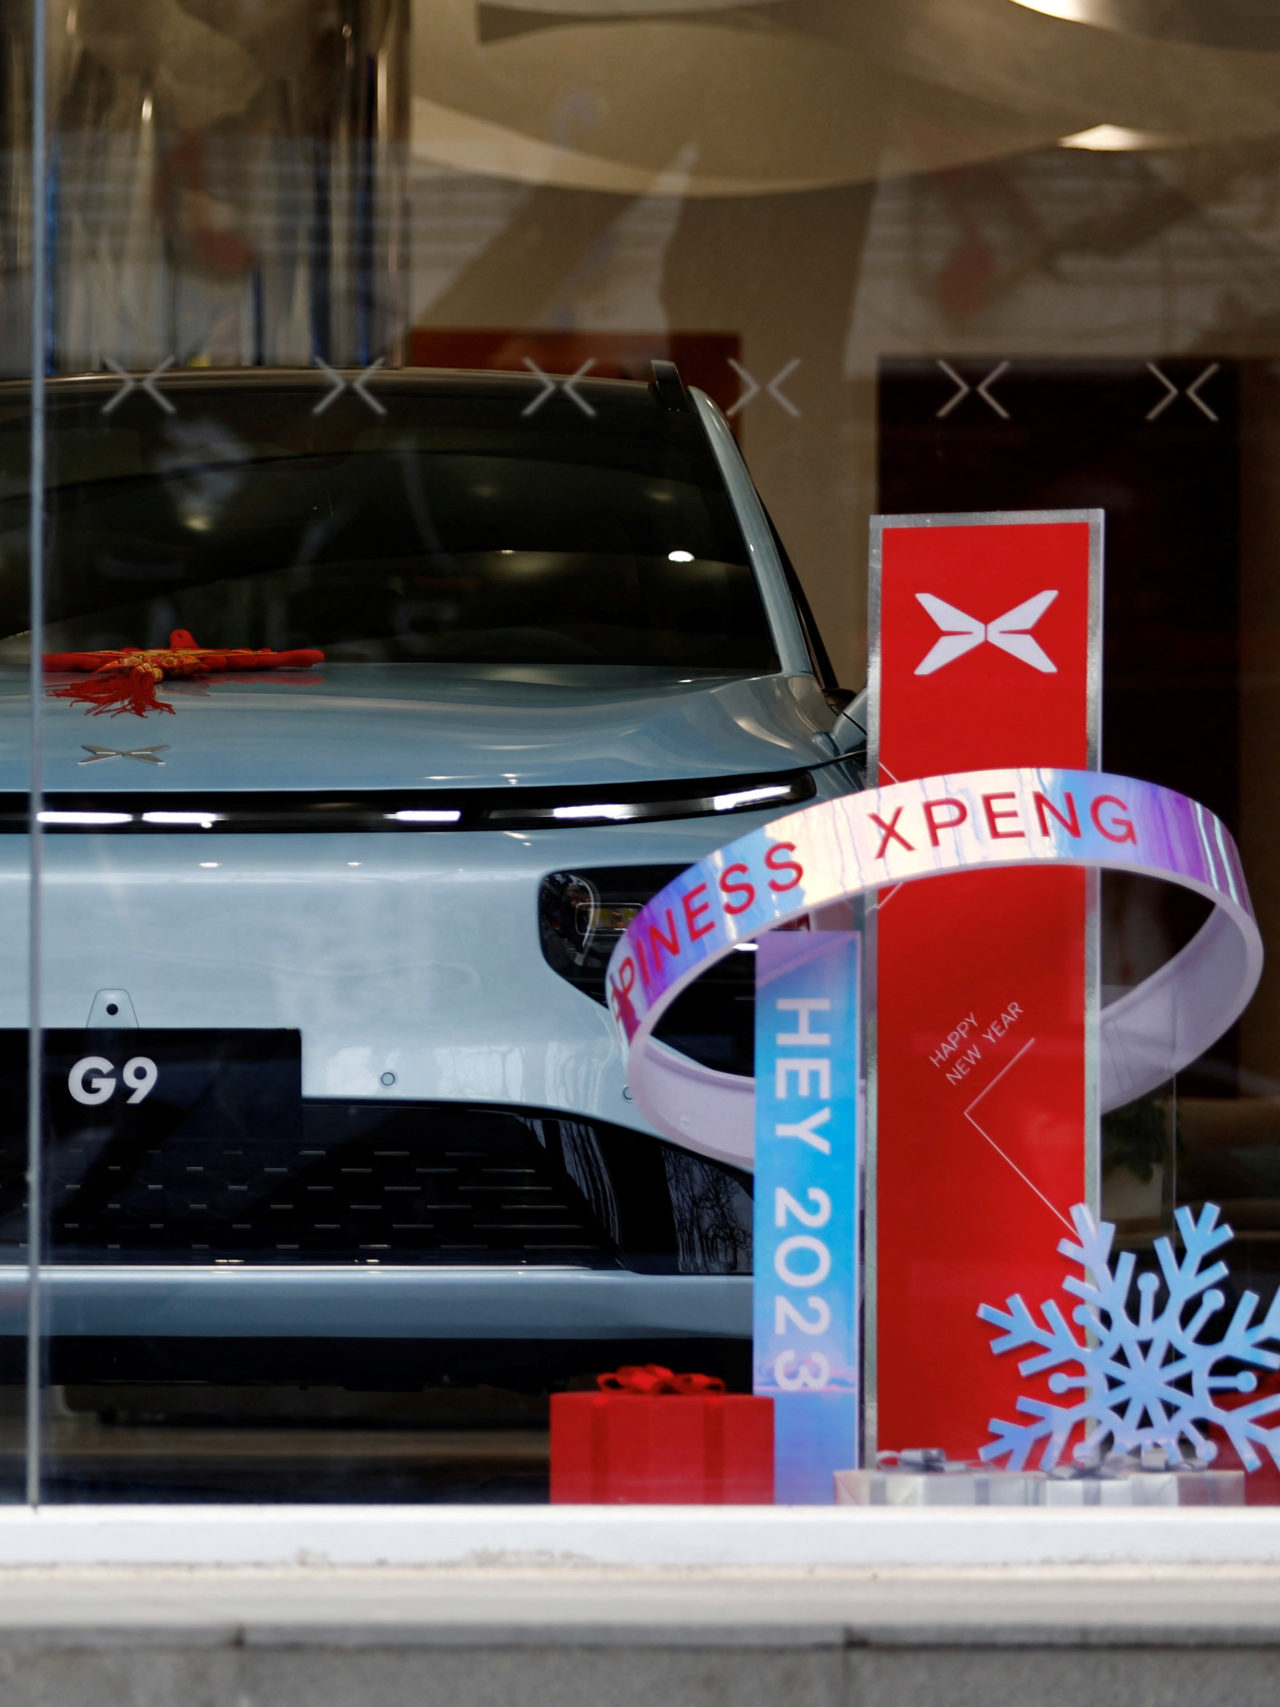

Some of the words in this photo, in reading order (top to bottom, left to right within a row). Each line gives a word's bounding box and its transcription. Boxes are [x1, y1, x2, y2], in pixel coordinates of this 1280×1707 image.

[866, 791, 1138, 860] XPENG
[775, 998, 832, 1155] HEY
[928, 1011, 979, 1068] HAPPY
[945, 1044, 983, 1086] NEW
[981, 1001, 1024, 1044] YEAR
[67, 1055, 159, 1106] G9
[774, 1187, 832, 1392] 2023
